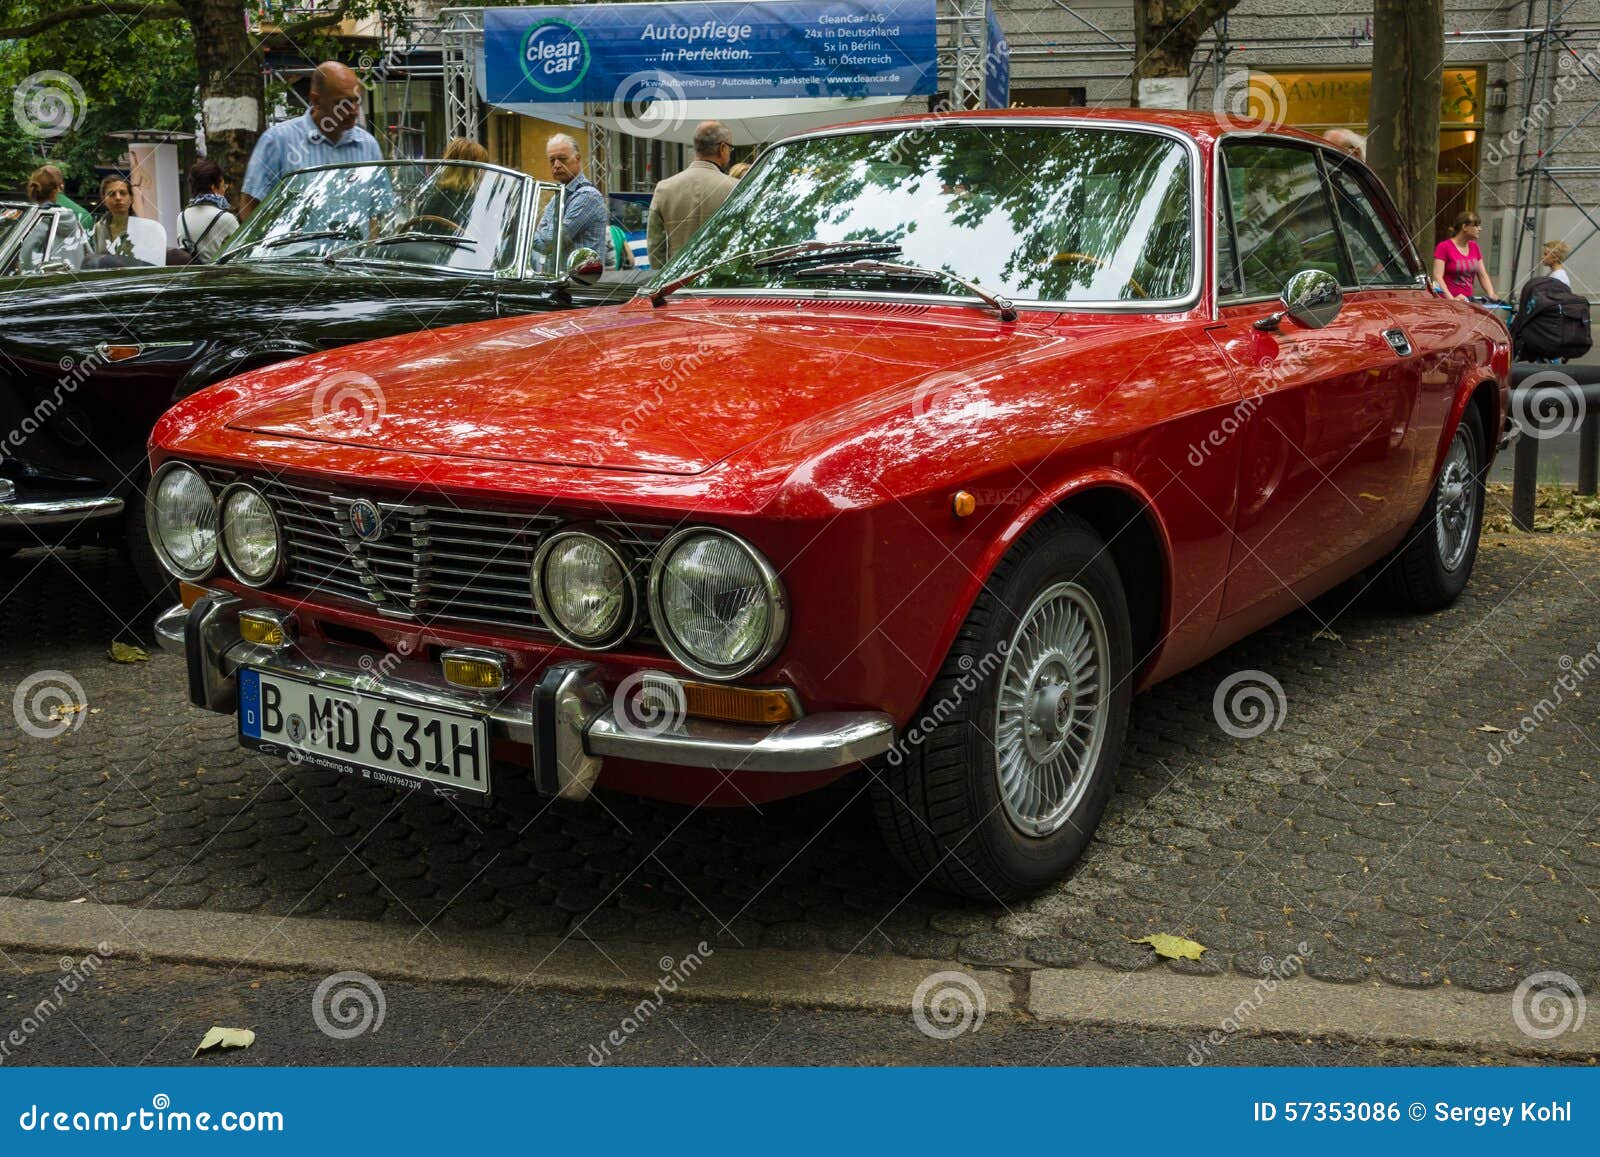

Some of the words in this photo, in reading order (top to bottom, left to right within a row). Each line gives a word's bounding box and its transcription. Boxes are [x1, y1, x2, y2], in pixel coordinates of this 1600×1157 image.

[869, 13, 886, 23] AG
[640, 21, 752, 44] Autopflege
[804, 28, 822, 39] 24x
[825, 28, 835, 38] in
[838, 26, 900, 37] Deutschland
[526, 40, 580, 61] clean
[824, 42, 836, 52] 5x
[839, 41, 848, 51] in
[851, 40, 881, 51] Berlin
[661, 48, 674, 62] in
[678, 47, 753, 61] Perfektion.
[814, 55, 826, 66] 3x
[829, 54, 838, 65] in
[840, 53, 892, 65] Österreich
[543, 55, 577, 75] car
[722, 76, 772, 86] Autowäsche
[779, 75, 820, 85] Tankstelle
[827, 73, 900, 84] www.cleancar.de
[247, 710, 255, 724] D
[262, 682, 284, 733] B
[308, 693, 360, 754] MD
[370, 708, 480, 781] 631H
